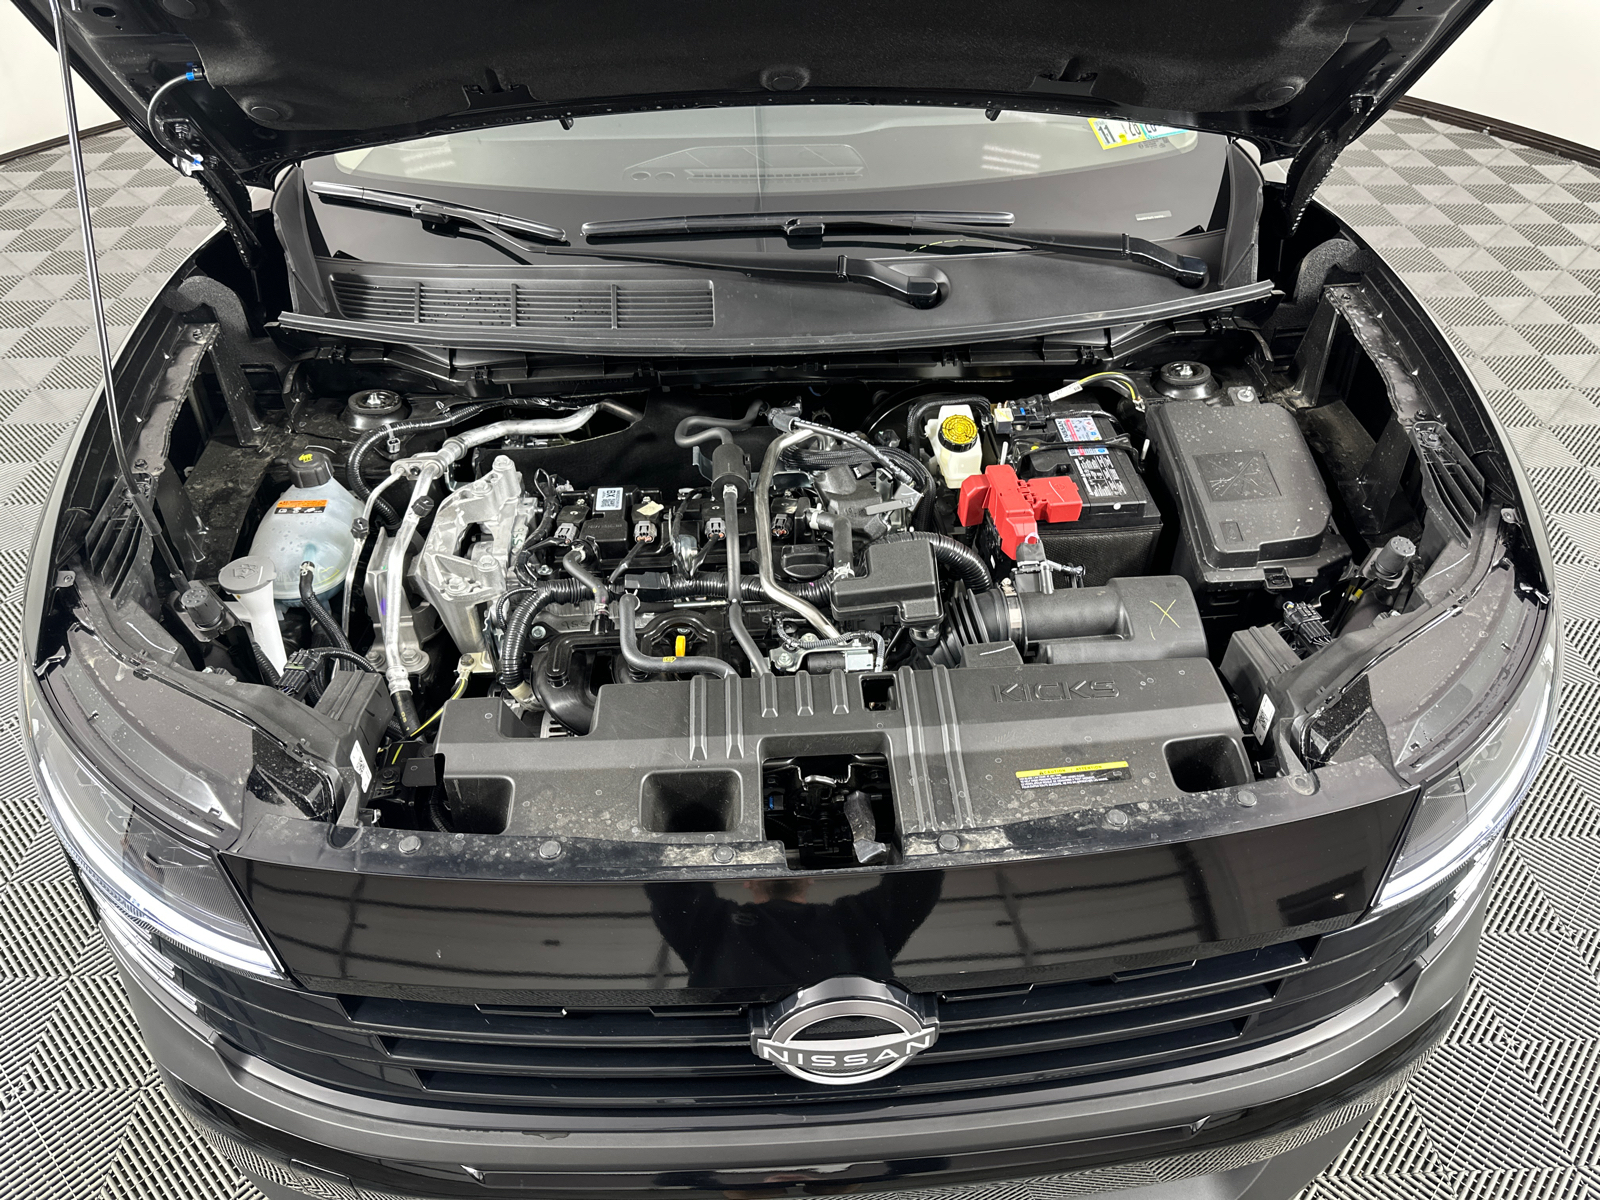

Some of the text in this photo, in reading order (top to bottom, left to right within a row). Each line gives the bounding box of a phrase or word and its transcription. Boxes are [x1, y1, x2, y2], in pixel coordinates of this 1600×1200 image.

[1098, 124, 1116, 144] 11
[992, 680, 1120, 703] KICKS
[763, 1035, 931, 1068] NISSAN
